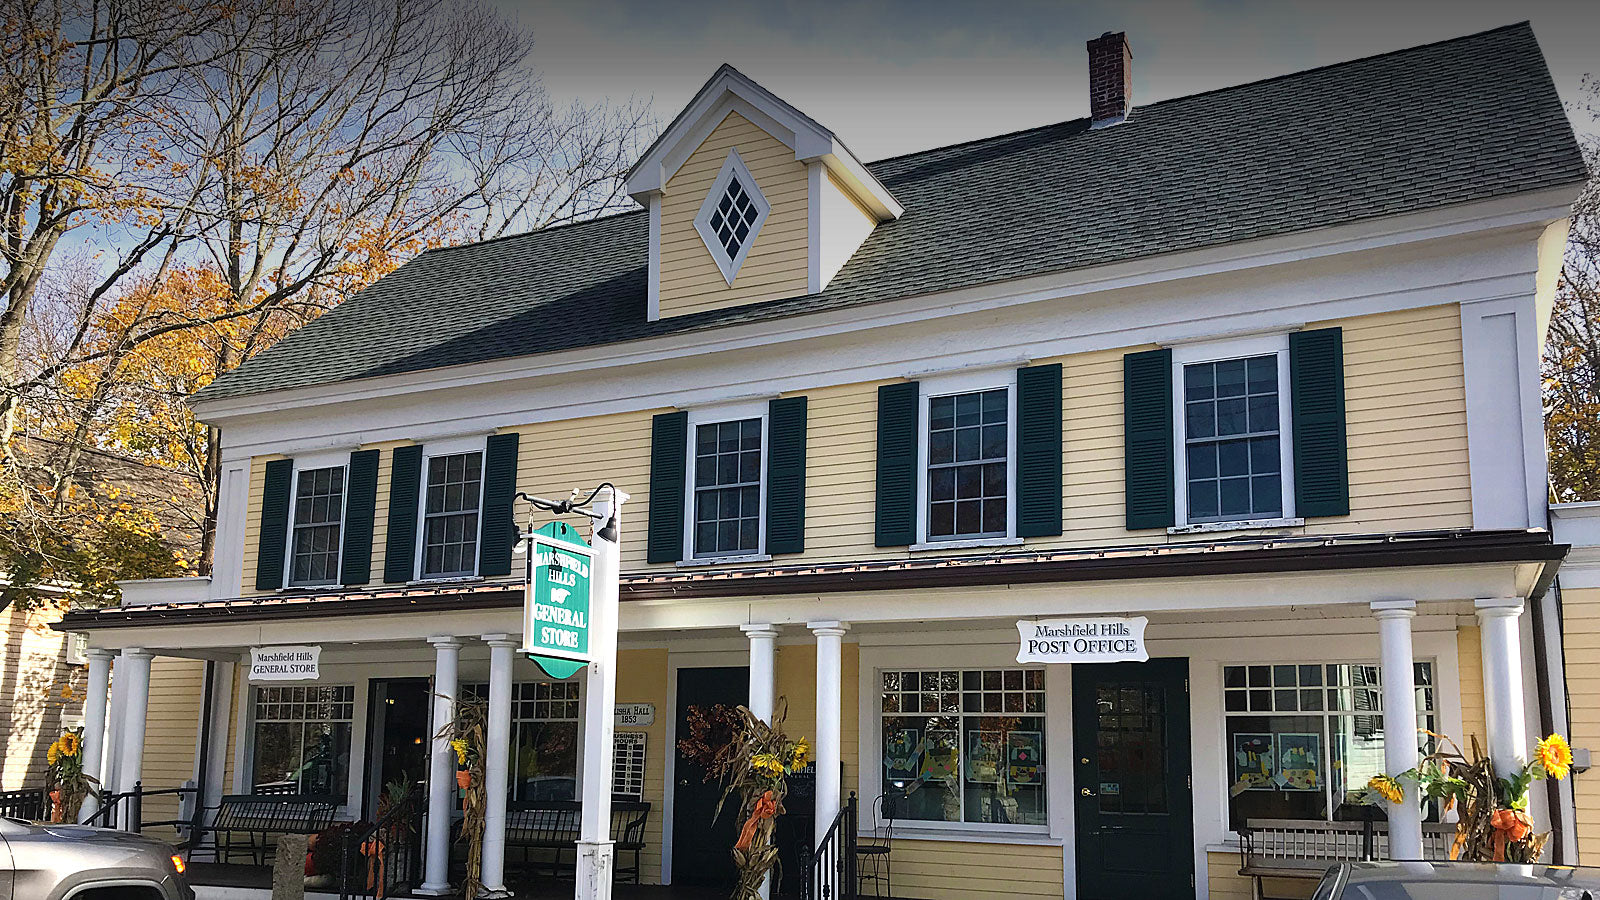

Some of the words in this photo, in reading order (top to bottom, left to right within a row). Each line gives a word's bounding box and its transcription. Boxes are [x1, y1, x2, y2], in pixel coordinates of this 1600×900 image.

[536, 551, 589, 579] MARSHFIELD
[548, 568, 576, 587] HILLS
[534, 603, 587, 629] GENERAL
[541, 626, 579, 648] STORE
[1035, 624, 1096, 637] Marshfield
[1101, 622, 1129, 636] Hills
[1028, 639, 1069, 654] POST
[1073, 638, 1136, 653] OFFICE
[257, 652, 294, 662] Marshfield
[296, 652, 313, 661] Hills
[253, 665, 288, 674] GENERAL
[290, 664, 315, 674] STORE
[614, 708, 631, 716] LISHA
[621, 715, 637, 723] 1853
